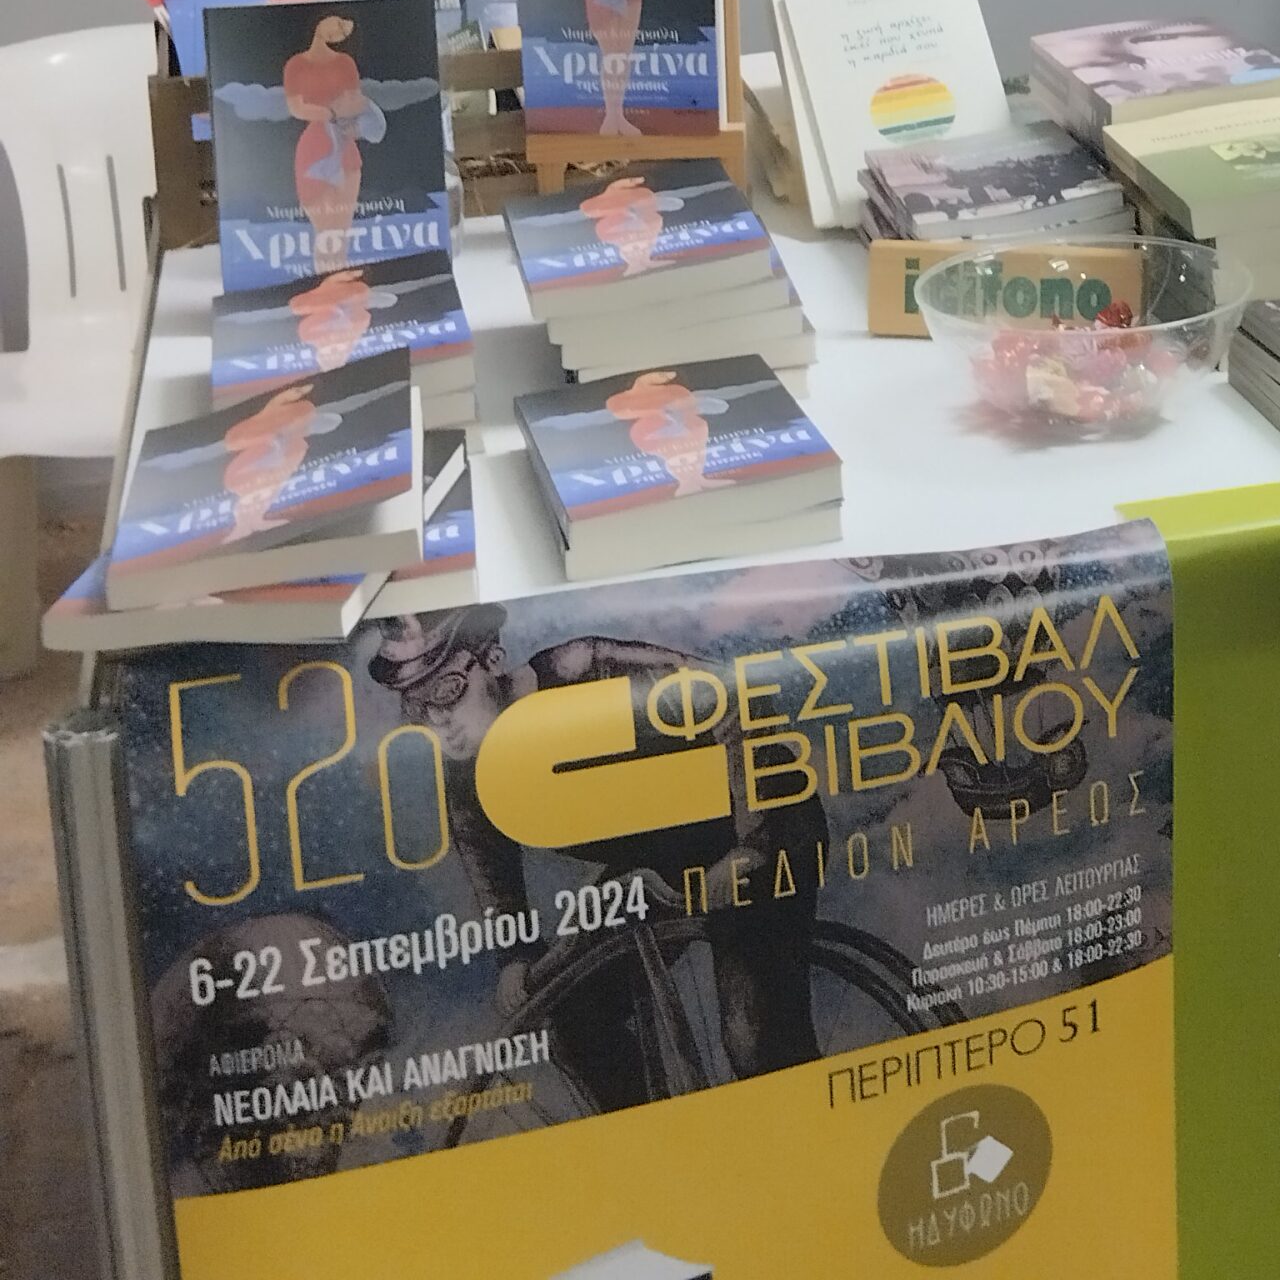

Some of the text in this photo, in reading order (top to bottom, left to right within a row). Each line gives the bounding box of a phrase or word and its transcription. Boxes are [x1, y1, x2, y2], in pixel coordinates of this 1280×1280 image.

[533, 43, 709, 84] Χριστίνα
[235, 214, 440, 268] Χριστίνα
[646, 594, 1141, 741] ΦΕΣΤΙΒΑΛ
[742, 667, 1139, 813] ΒΙΒΛΙΟΥ
[683, 770, 1147, 917] ΠΕΔΙΟΝ ΑΡΕΩΣ
[926, 853, 1142, 927] ΗΜΕΡΕΣ & ΩΡΕΣ ΛΕΙΤΟΥΡΓΙΑΣ
[189, 875, 649, 1007] 6-22 Σεπτεμβρίου 2024
[911, 953, 989, 987] Παρασκευή
[1008, 934, 1063, 963] Σάββατο
[923, 934, 979, 960] Δευτέρα
[1014, 912, 1061, 939] Πέμπτη
[906, 984, 963, 1013] Κυριακή
[968, 959, 1048, 996] 10:30-15:00
[213, 1029, 550, 1127] ΝΕΟΛΑΙΑ ΚΑΙ ΑΝΑΓΝΩΣΗ
[827, 997, 1103, 1109] ΠΕΡΙΠΤΕΡΟ 51
